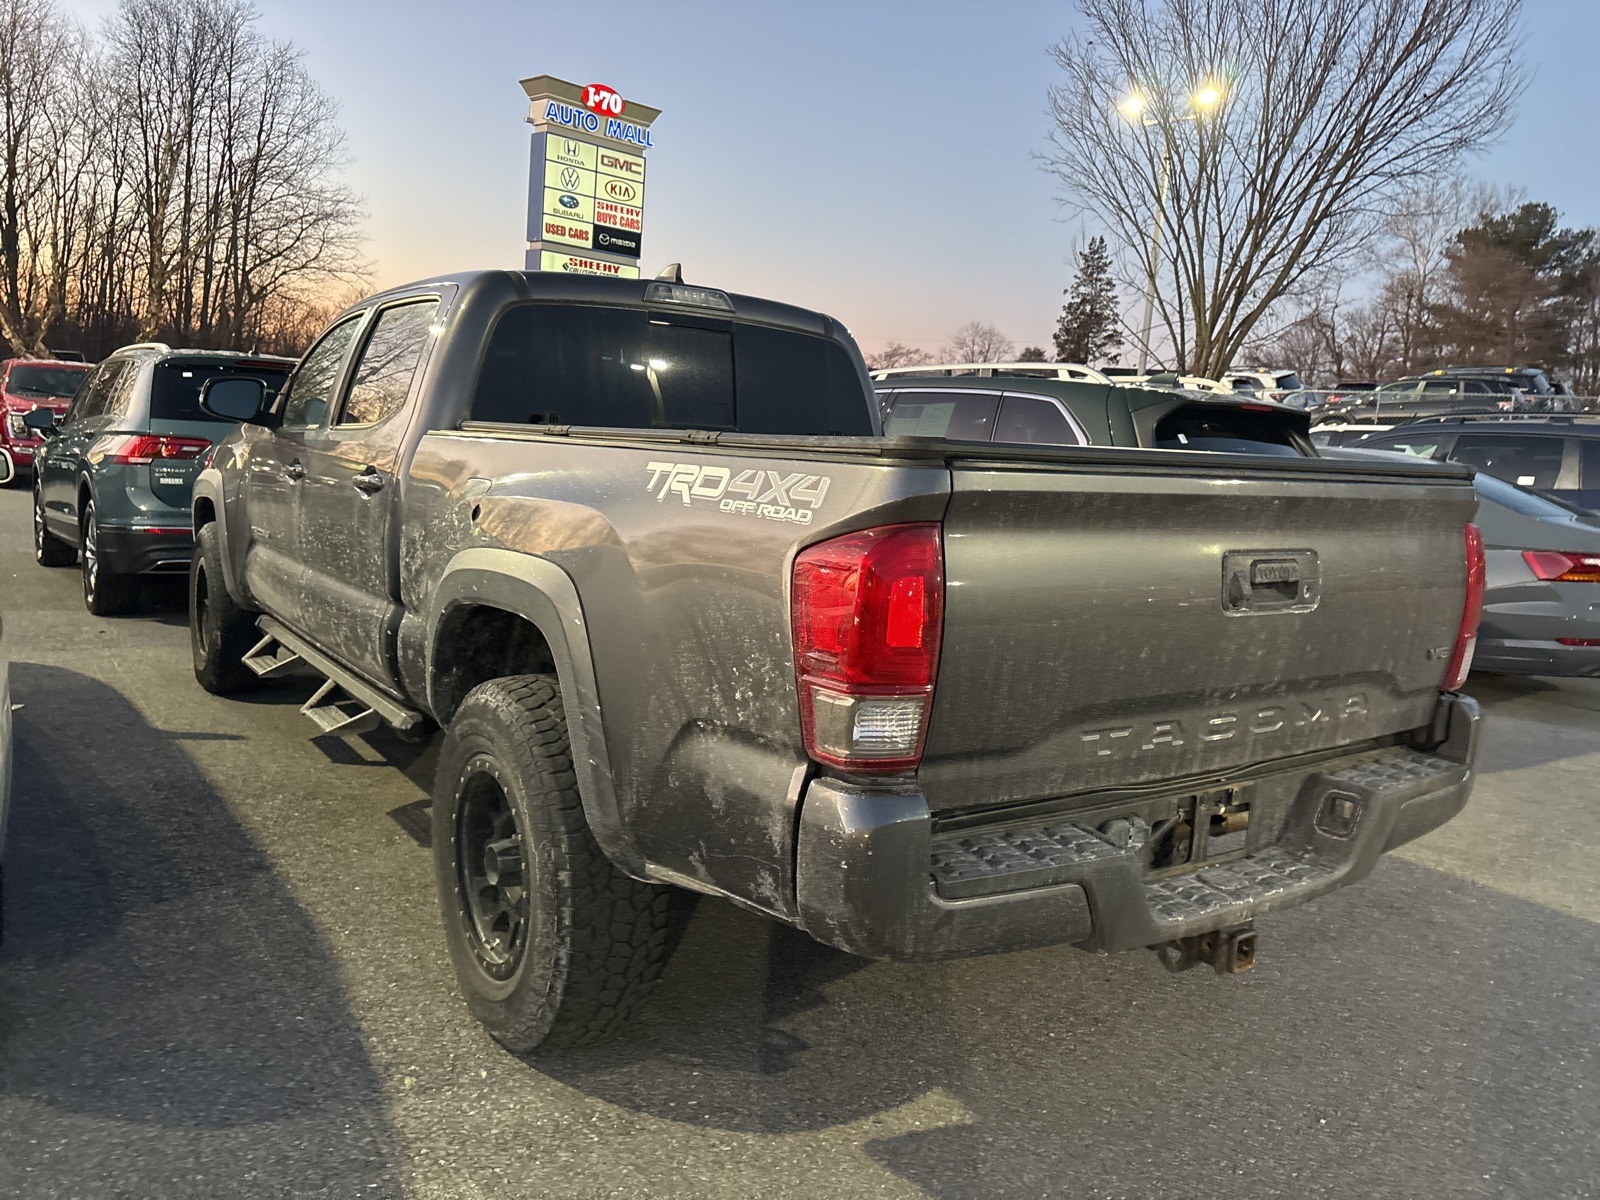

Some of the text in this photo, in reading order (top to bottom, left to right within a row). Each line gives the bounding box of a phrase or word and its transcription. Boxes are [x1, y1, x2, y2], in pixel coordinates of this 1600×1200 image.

[545, 100, 655, 148] AUTO MALL
[556, 155, 585, 167] HONDA
[601, 154, 642, 176] GMC
[610, 183, 630, 198] KIA
[552, 207, 584, 220] SUBARU
[596, 201, 641, 217] SHEEHY
[596, 211, 641, 231] BUYS CARS
[545, 222, 590, 242] USED CARS
[610, 237, 636, 249] mazda
[569, 257, 621, 274] SHEEHY
[646, 461, 731, 507] TRD
[719, 498, 813, 526] OFF ROAD
